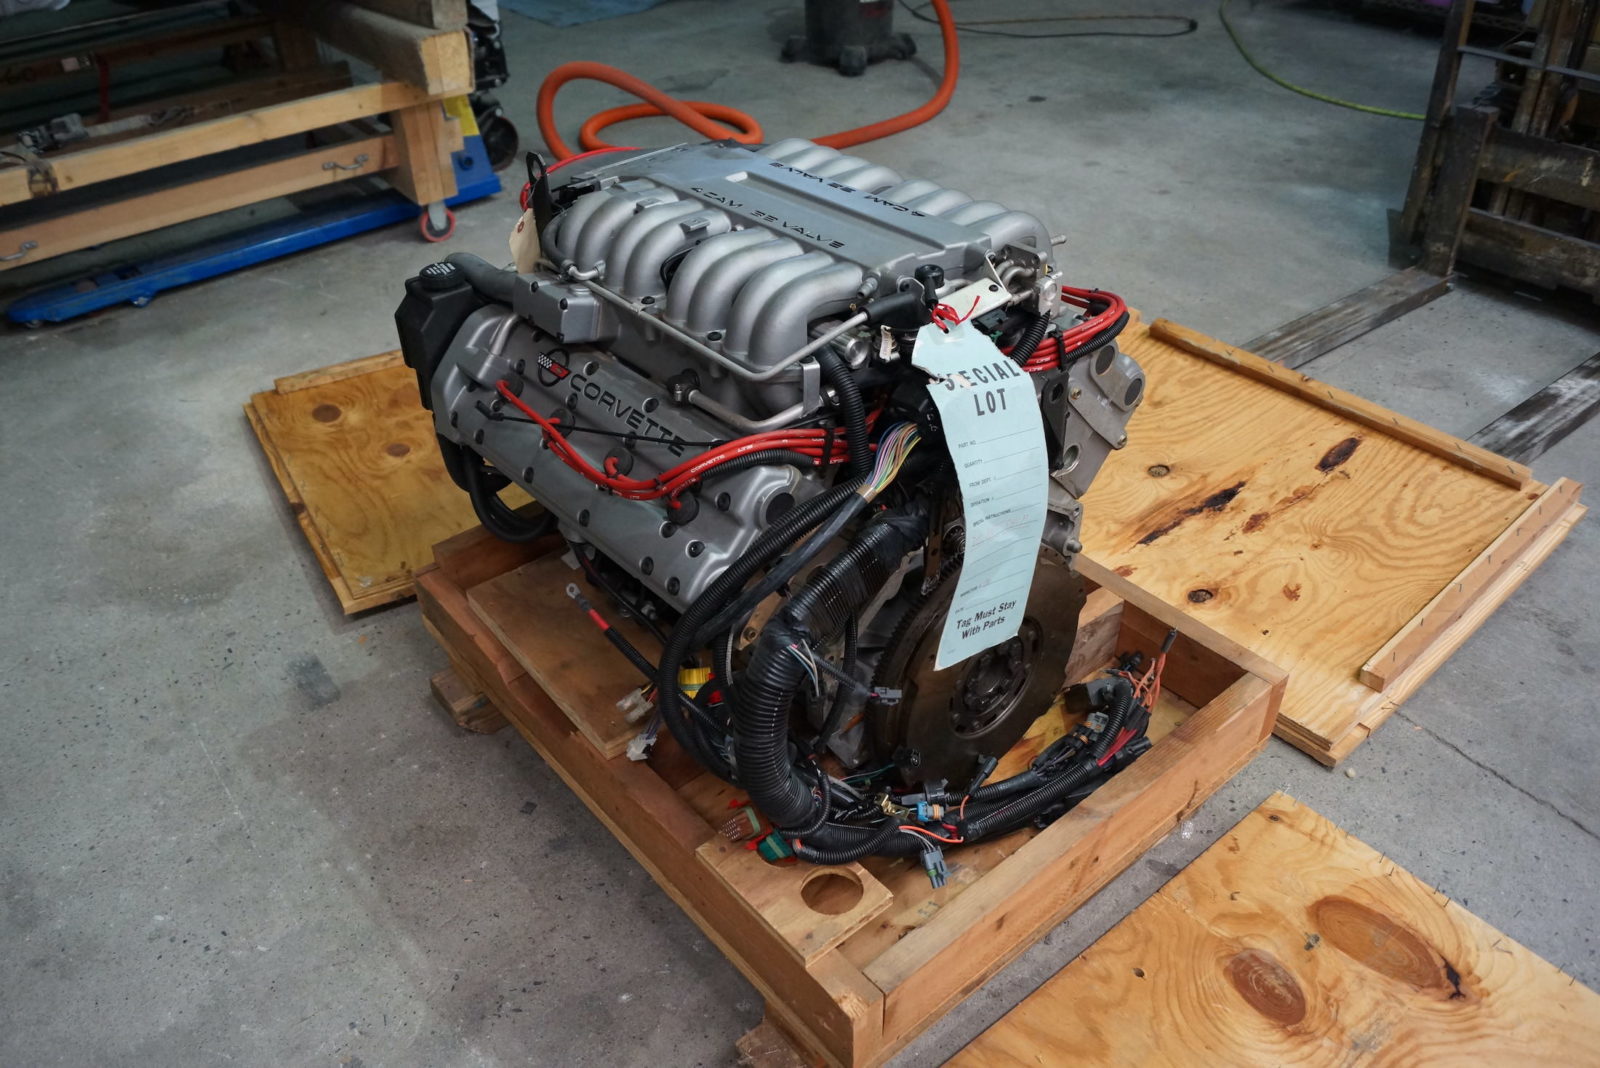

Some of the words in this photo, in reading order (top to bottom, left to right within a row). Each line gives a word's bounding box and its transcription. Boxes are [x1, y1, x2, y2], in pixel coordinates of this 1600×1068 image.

[769, 162, 823, 183] VALVE
[864, 195, 909, 212] CAM
[704, 192, 743, 208] CAM
[782, 220, 846, 249] VALVE
[945, 360, 1021, 391] SECIAL
[570, 373, 687, 458] CORVETTE
[974, 388, 1007, 417] LOT
[690, 454, 726, 473] CORVETTE
[957, 618, 972, 630] Tag
[974, 606, 997, 622] Must
[998, 600, 1017, 613] Stay
[962, 625, 981, 640] With
[983, 616, 1006, 631] Parts
